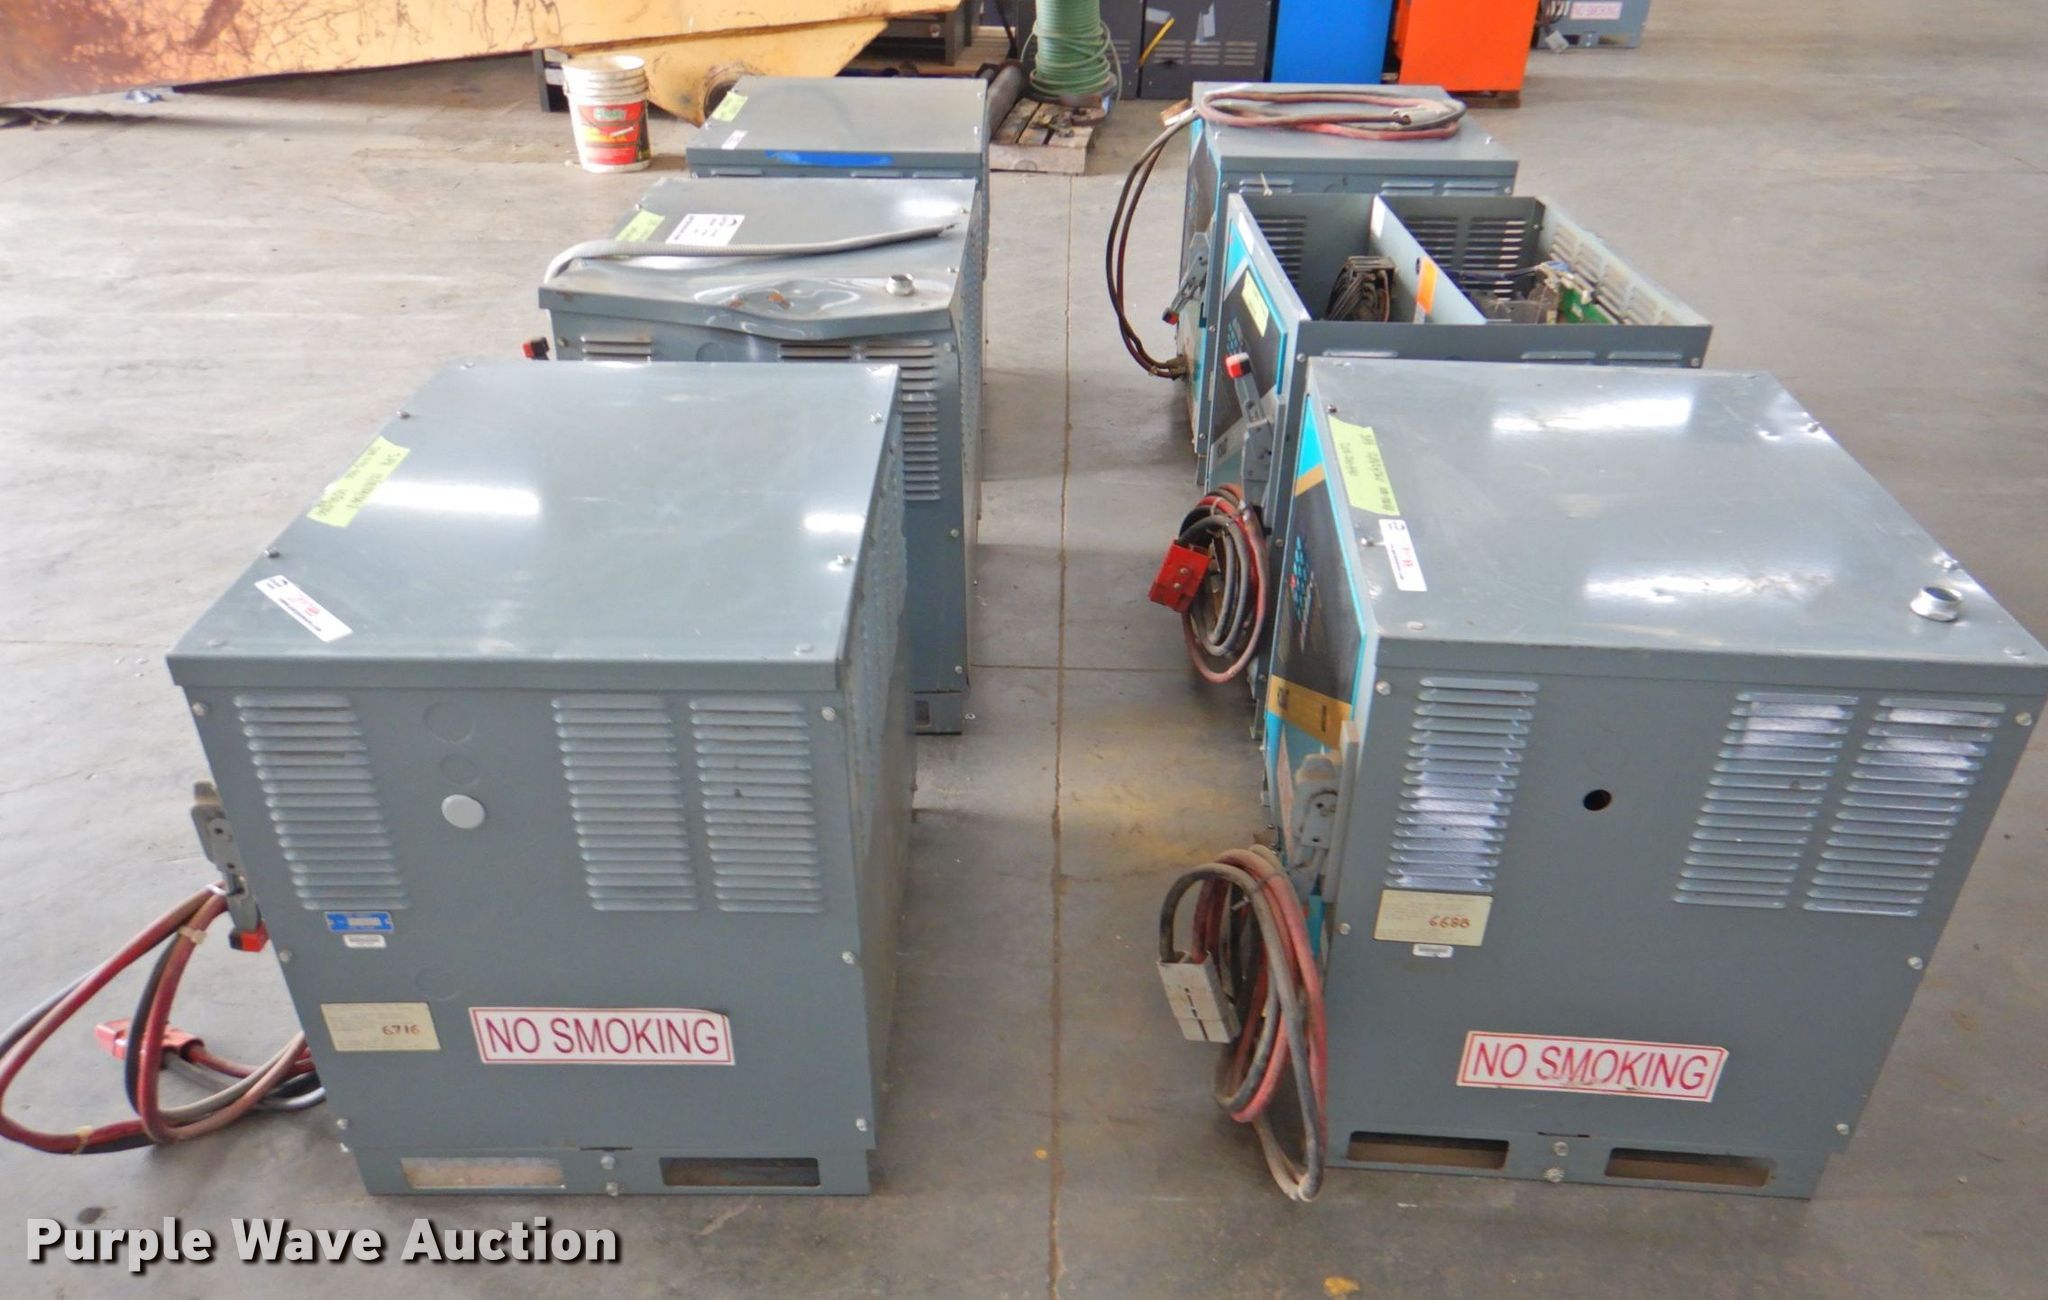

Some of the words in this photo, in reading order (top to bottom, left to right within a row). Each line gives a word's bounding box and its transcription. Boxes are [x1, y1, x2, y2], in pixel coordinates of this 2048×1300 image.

[382, 1024, 421, 1036] 6716
[484, 1017, 541, 1054] NO
[551, 1017, 720, 1055] SMOKING
[1473, 1041, 1528, 1078] NO
[1536, 1045, 1708, 1091] SMOKING
